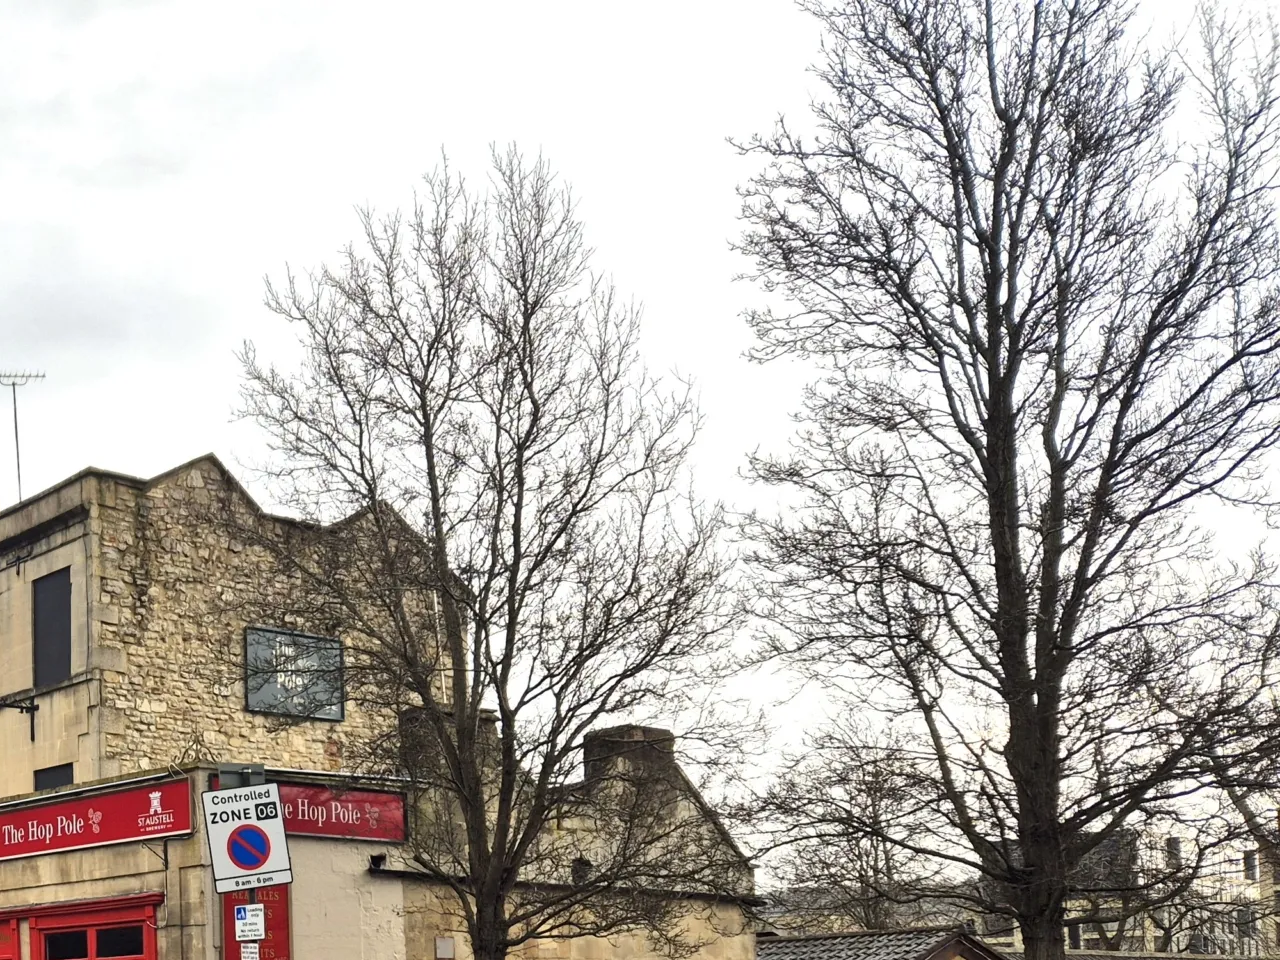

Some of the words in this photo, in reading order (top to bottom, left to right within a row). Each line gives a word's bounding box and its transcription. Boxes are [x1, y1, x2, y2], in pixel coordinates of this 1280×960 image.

[211, 789, 271, 805] Controlled
[145, 813, 175, 826] AUSTELL
[210, 808, 252, 824] ZONE
[257, 804, 276, 818] 06
[297, 799, 326, 827] Hop
[331, 801, 361, 824] Pole
[2, 824, 25, 845] The
[27, 820, 54, 844] Hop
[56, 813, 84, 836] Pole
[262, 876, 274, 884] pm
[257, 891, 279, 900] ALES
